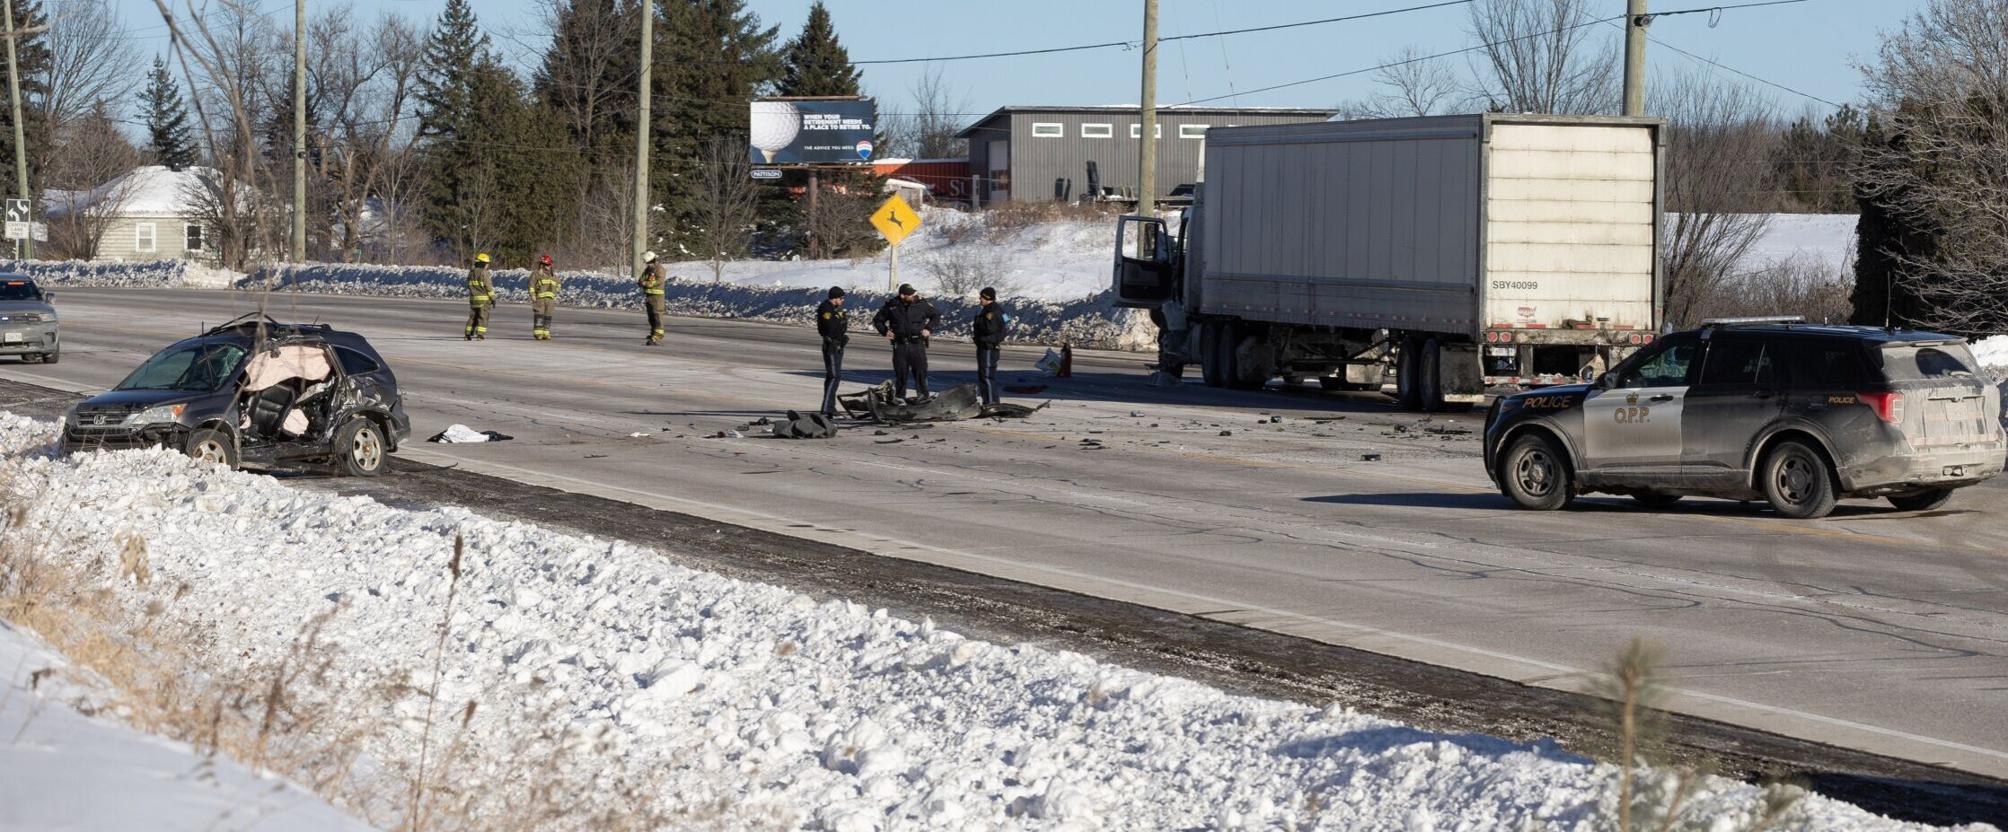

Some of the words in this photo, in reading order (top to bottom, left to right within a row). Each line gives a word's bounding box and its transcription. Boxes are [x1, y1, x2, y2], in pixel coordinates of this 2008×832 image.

[1492, 281, 1538, 289] SBY40099
[1522, 396, 1571, 408] POLICE
[1828, 396, 1856, 404] POLICE
